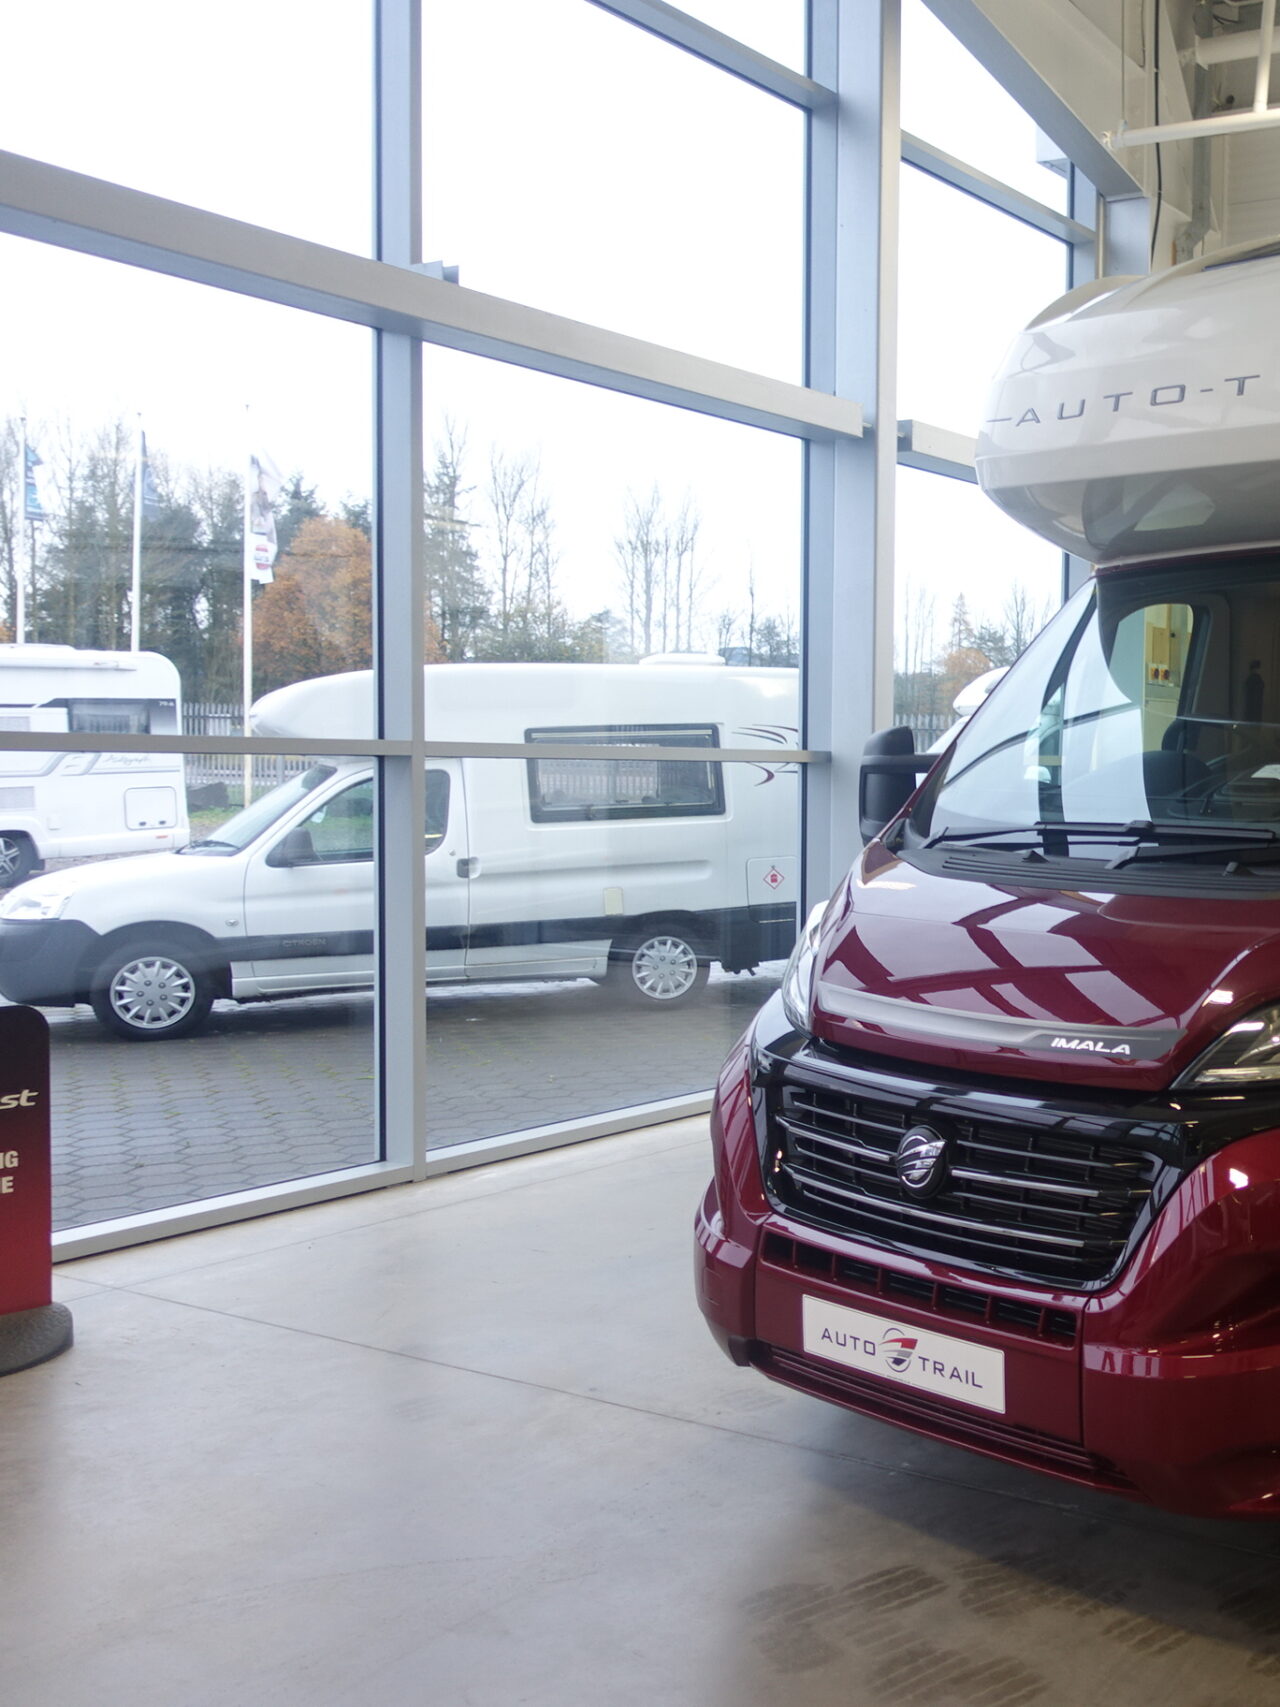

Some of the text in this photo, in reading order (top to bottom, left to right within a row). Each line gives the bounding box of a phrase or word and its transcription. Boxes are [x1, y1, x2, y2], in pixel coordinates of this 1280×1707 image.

[1051, 1037, 1131, 1055] IMALA
[821, 1327, 983, 1389] AUTO TRAIL
